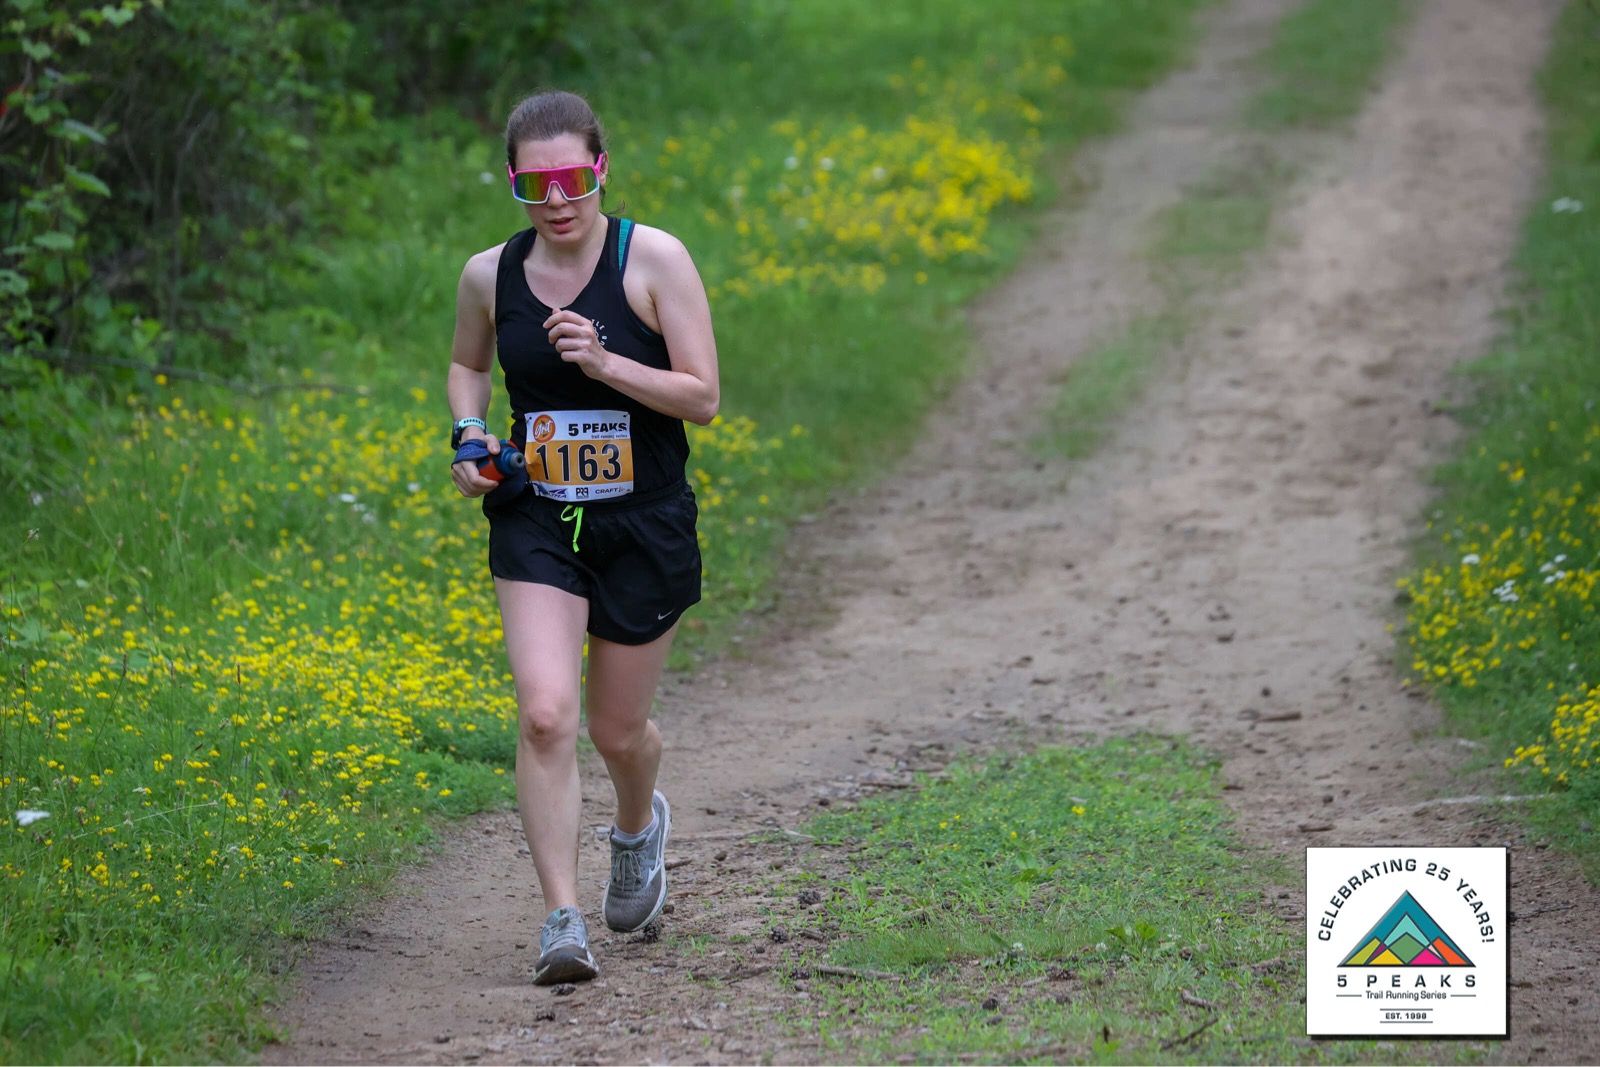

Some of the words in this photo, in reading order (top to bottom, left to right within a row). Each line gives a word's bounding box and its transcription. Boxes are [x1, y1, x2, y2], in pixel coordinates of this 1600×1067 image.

[568, 424, 579, 437] 5
[583, 423, 627, 433] PEAKS
[536, 444, 621, 482] 1163
